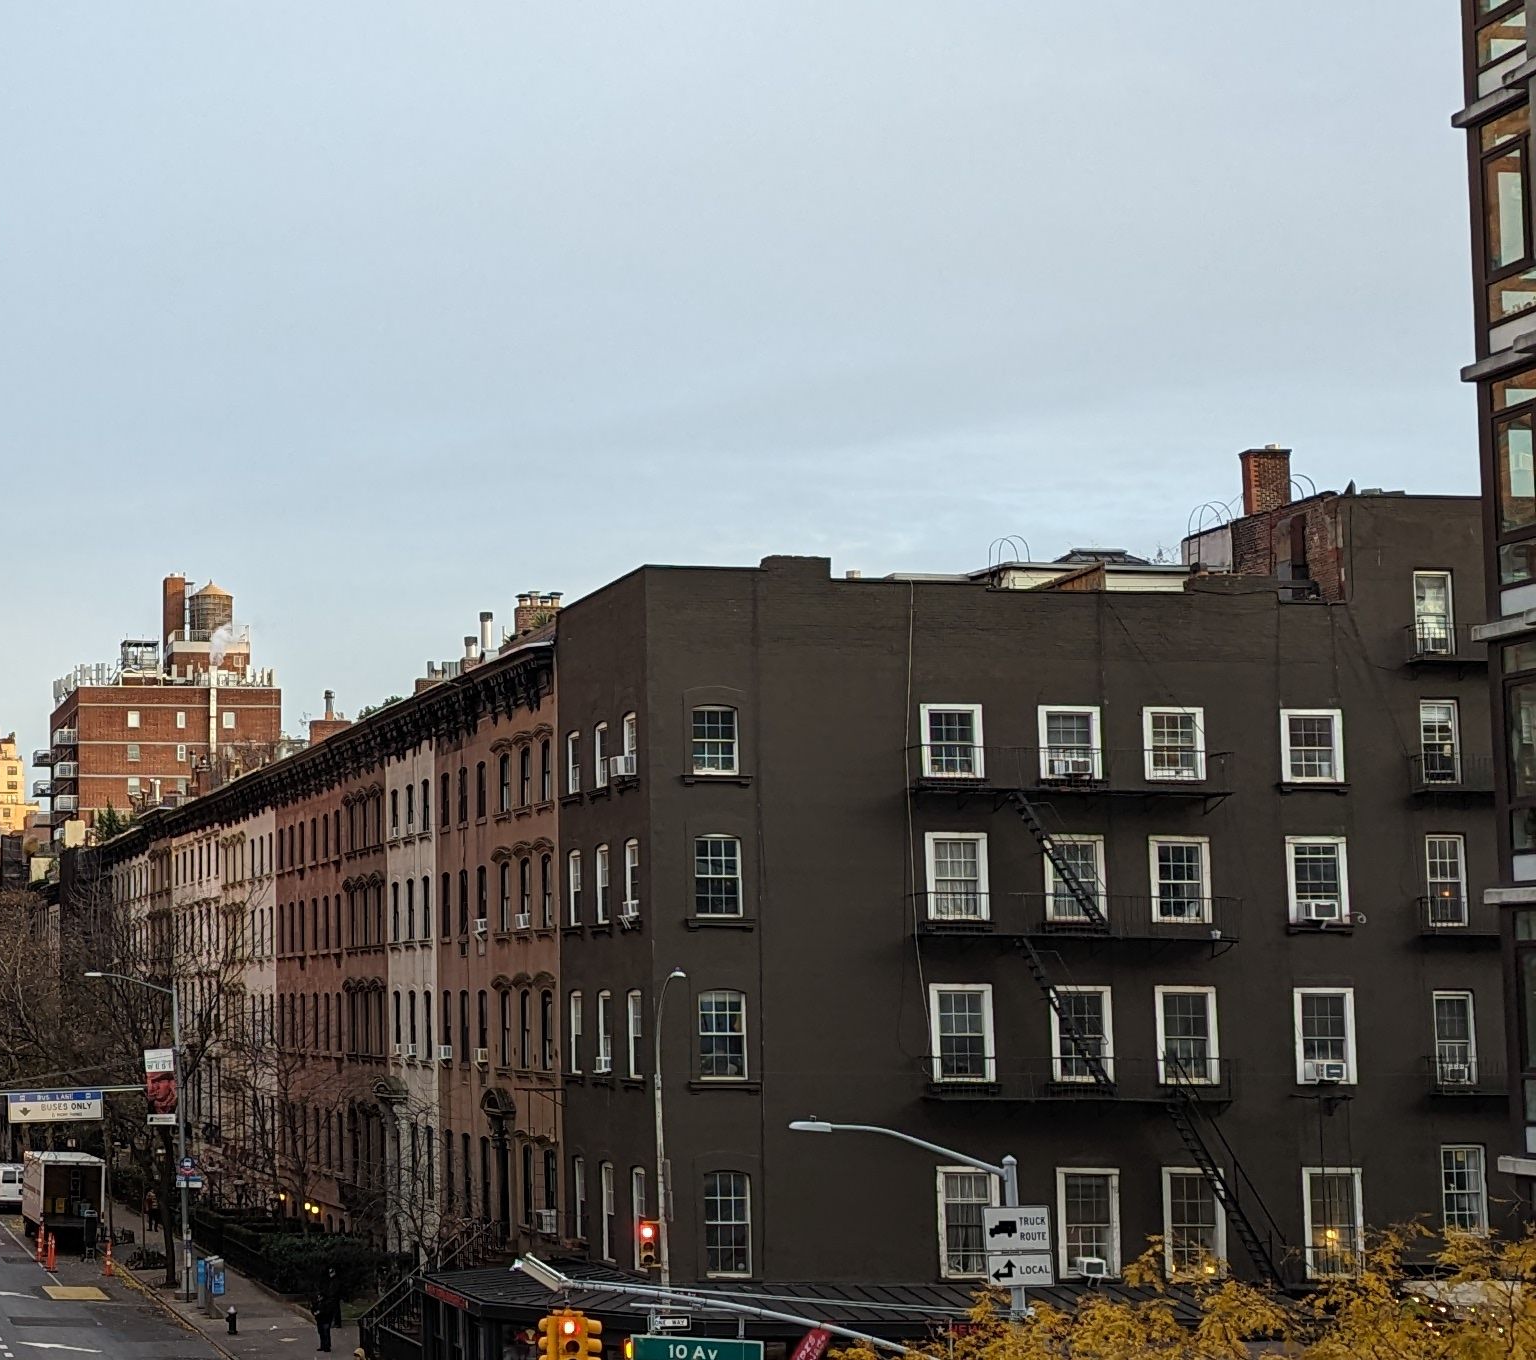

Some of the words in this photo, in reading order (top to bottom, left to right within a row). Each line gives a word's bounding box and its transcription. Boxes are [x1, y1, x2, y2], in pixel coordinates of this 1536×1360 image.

[41, 1102, 68, 1111] BUSES
[70, 1102, 92, 1110] ONLY
[1019, 1217, 1046, 1226] TRUCK
[1020, 1232, 1047, 1241] ROUTE
[1020, 1265, 1050, 1275] LOCAL
[668, 1343, 688, 1359] 10
[692, 1345, 718, 1360] Av
